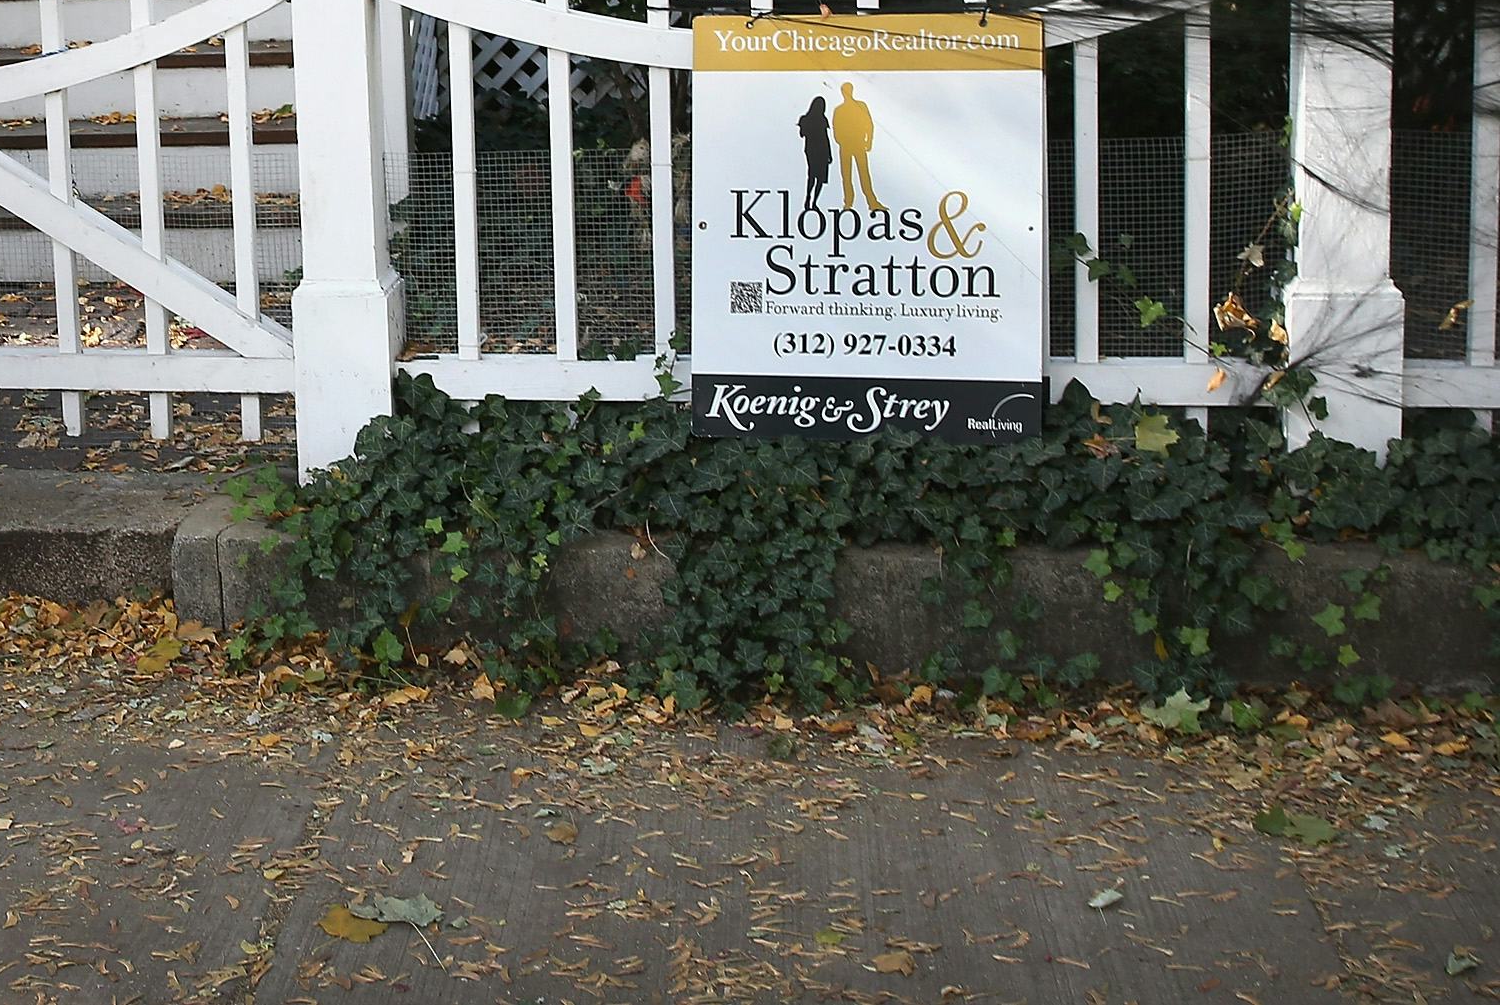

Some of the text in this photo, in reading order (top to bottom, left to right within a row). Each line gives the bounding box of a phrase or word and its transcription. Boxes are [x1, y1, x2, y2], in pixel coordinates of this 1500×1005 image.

[713, 28, 1019, 57] YourChicagoRealtor.com
[729, 189, 987, 260] Klopas &
[764, 244, 1001, 298] Stratton
[765, 300, 1003, 323] Forward thinking. Luxury living.
[773, 332, 957, 359] (312) 927-0334
[705, 384, 950, 433] Koenig & Strey
